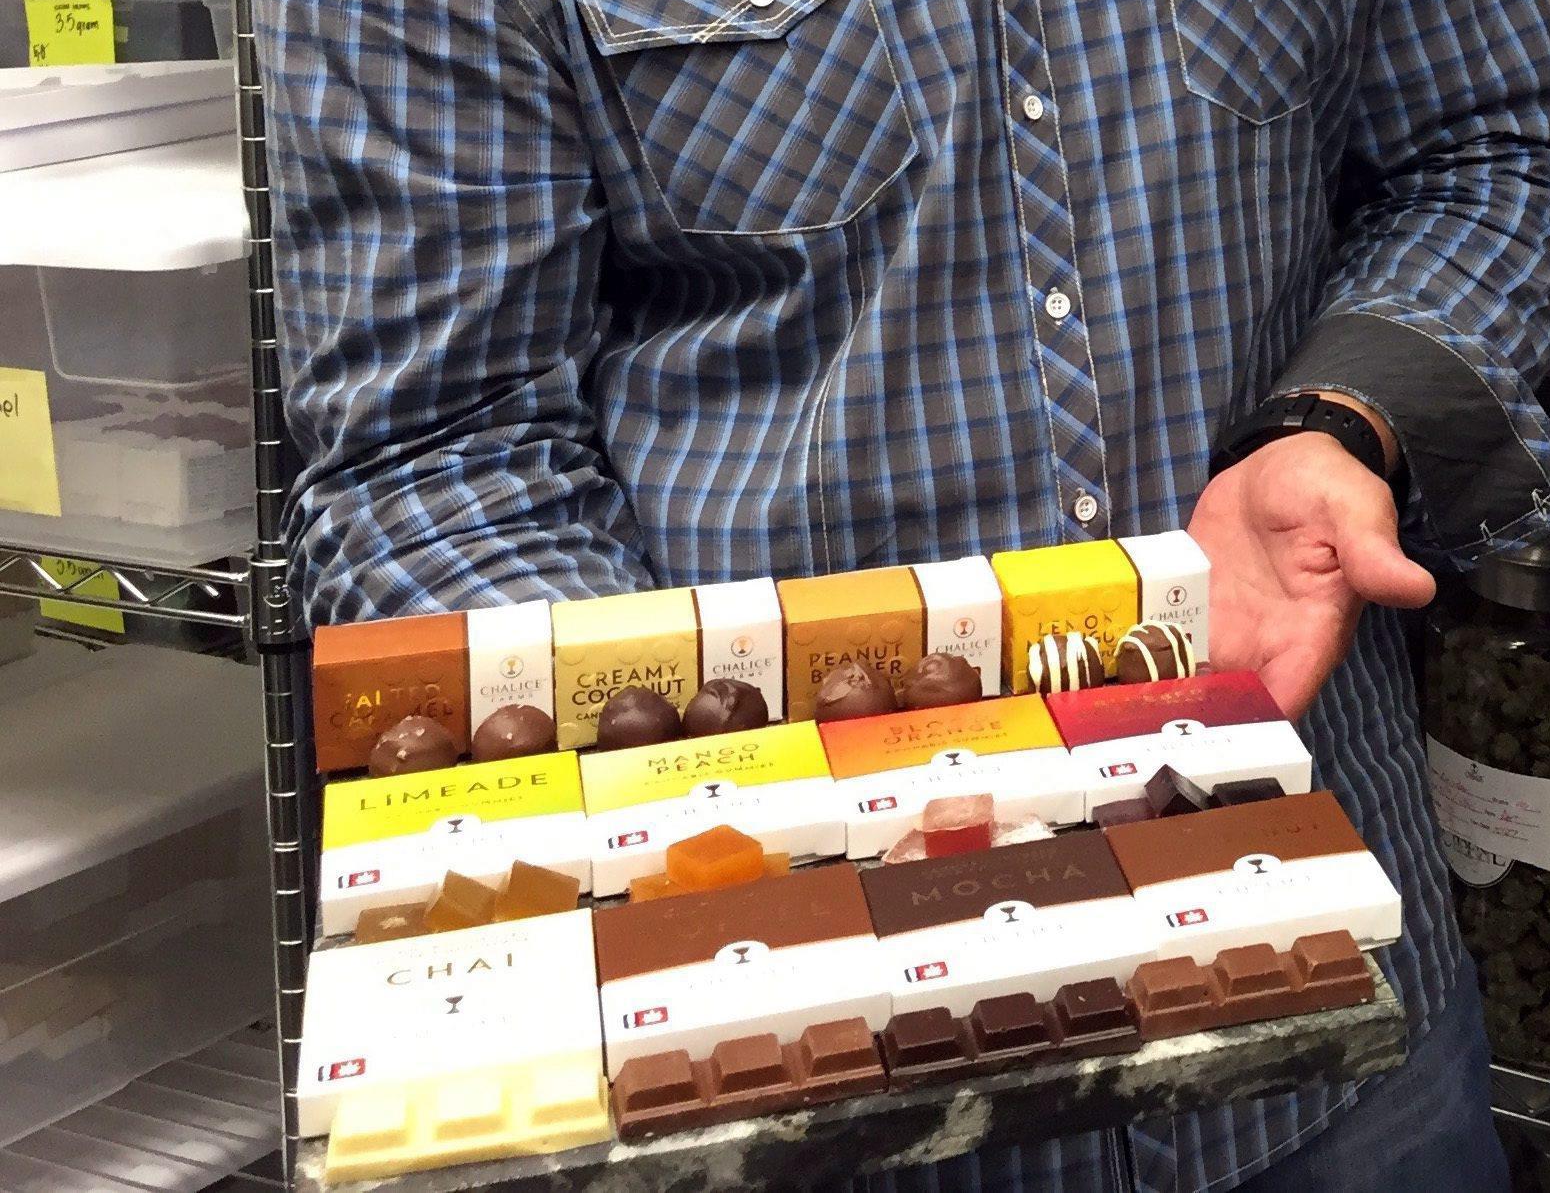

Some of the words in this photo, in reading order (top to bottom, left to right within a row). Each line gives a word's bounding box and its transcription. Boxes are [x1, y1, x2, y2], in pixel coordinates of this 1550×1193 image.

[577, 661, 680, 689] CREAMY
[648, 743, 760, 768] MANGO
[360, 772, 548, 811] LIMEADE
[911, 863, 1087, 906] MOCHA
[387, 952, 513, 986] CHAI
